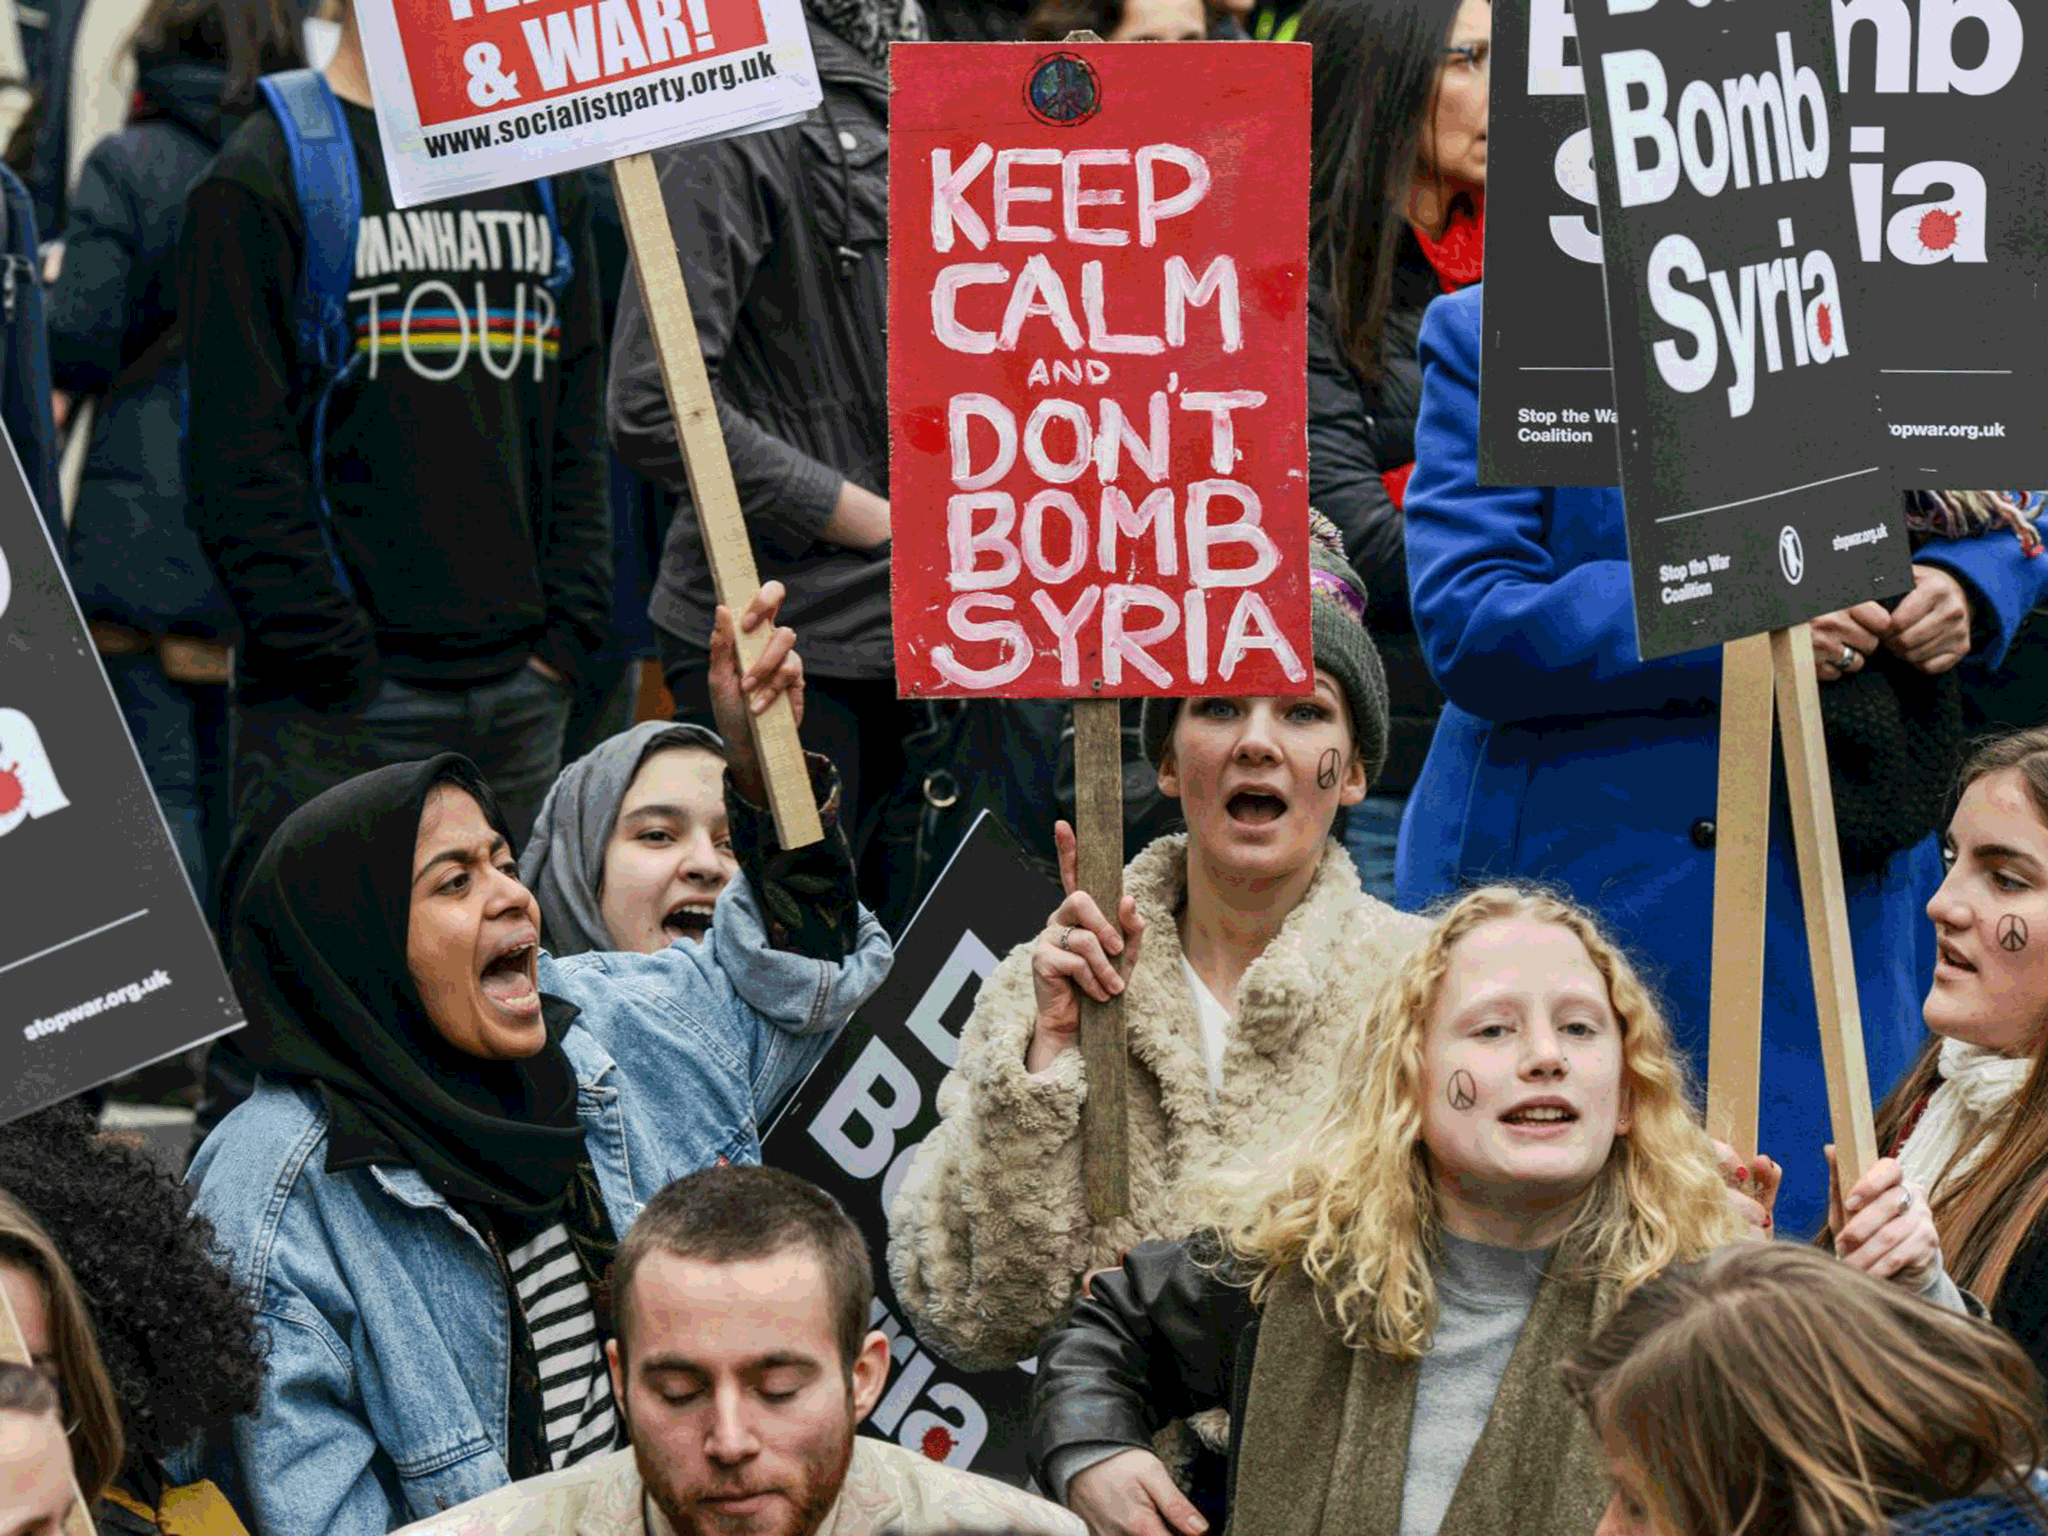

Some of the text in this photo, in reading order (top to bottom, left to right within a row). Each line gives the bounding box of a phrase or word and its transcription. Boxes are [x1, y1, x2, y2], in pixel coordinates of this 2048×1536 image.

[424, 51, 777, 159] www.socialistparty.org.uk
[463, 0, 716, 108] & WAR!
[1601, 31, 1830, 208] Bomb
[931, 142, 1211, 253] KEEP
[930, 252, 1244, 355] CALM
[1647, 218, 1849, 418] Syria
[1028, 358, 1111, 388] AND
[1517, 407, 1558, 426] Stop
[1561, 408, 1591, 423] the
[948, 372, 1268, 491] DON'T
[1517, 427, 1593, 443] Coalition
[1887, 421, 2007, 441] opwar.org.uk
[947, 478, 1283, 592] BOMB
[1659, 553, 1731, 582] Stop the War
[929, 583, 1307, 690] SYRIA
[1660, 580, 1713, 605] Coalition
[23, 968, 173, 1041] stopwar.org.uk
